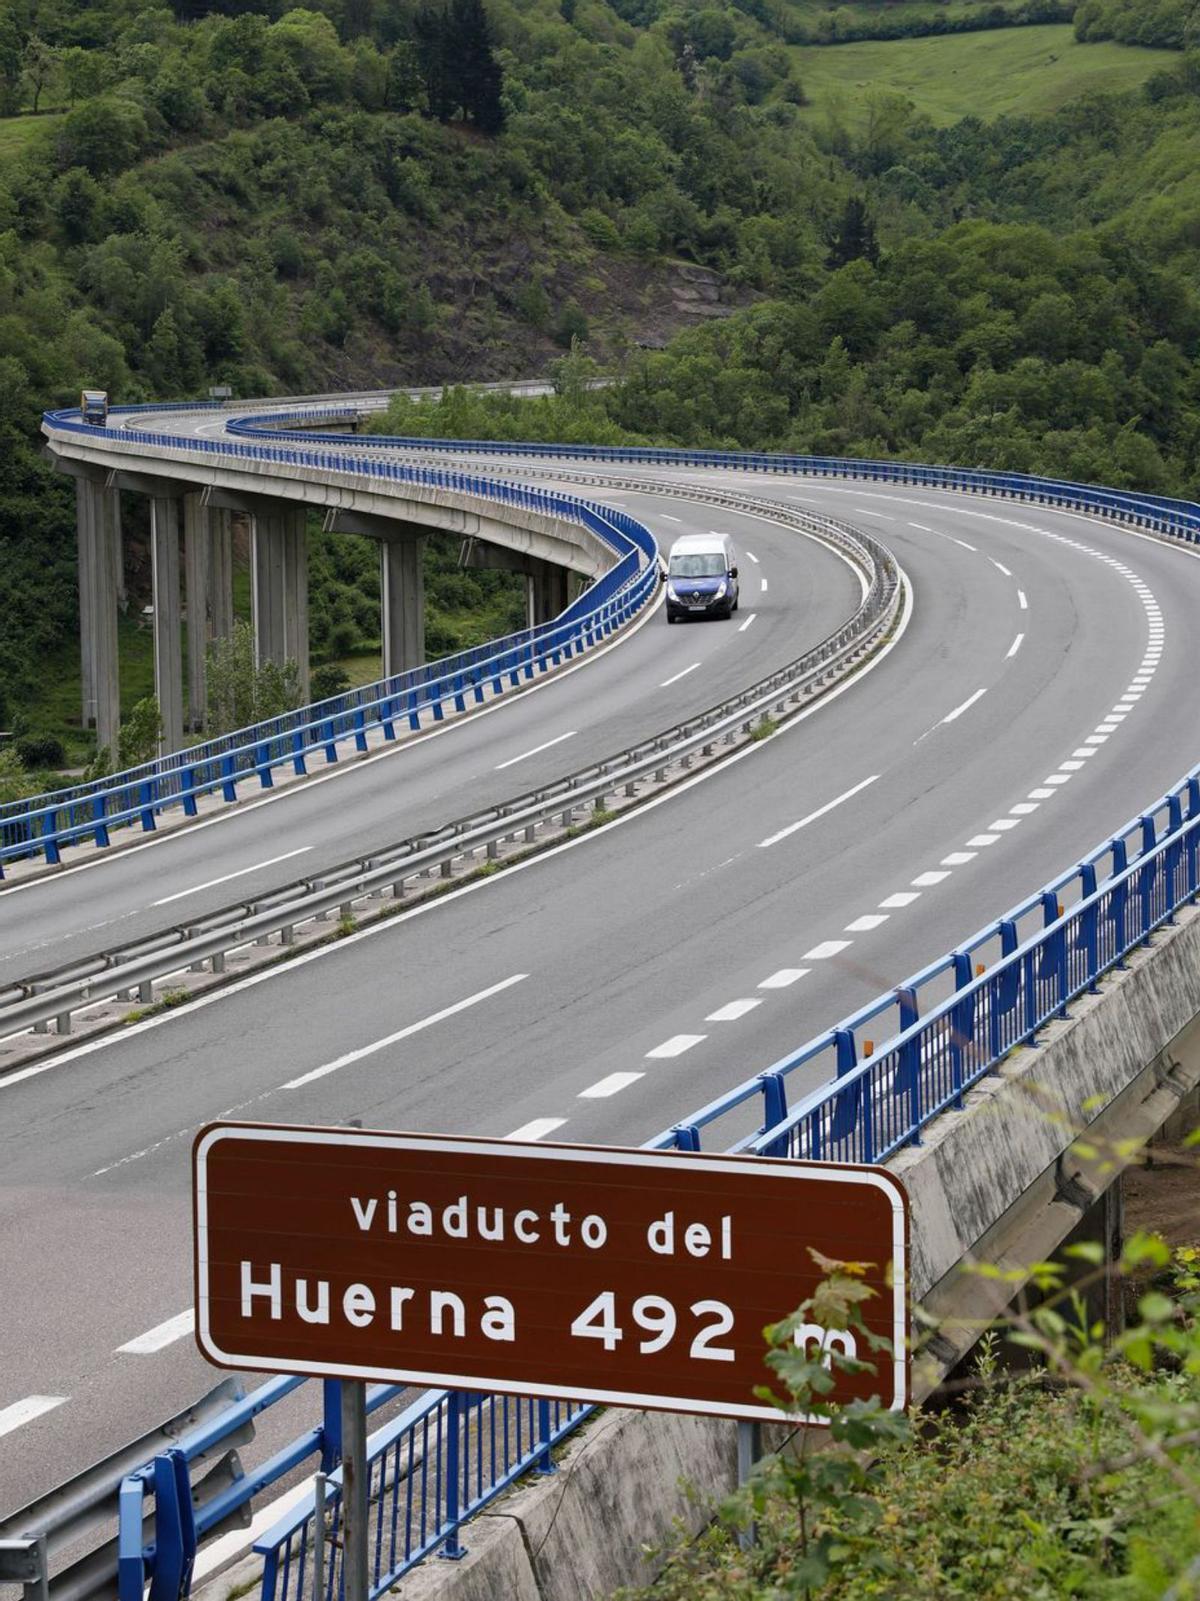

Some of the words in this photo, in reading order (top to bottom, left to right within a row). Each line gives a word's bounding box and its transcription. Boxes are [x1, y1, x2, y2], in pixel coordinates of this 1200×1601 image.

[350, 1190, 608, 1249] viaducto
[647, 1211, 732, 1260] del
[240, 1260, 516, 1342] Huerna
[570, 1291, 736, 1362] 492
